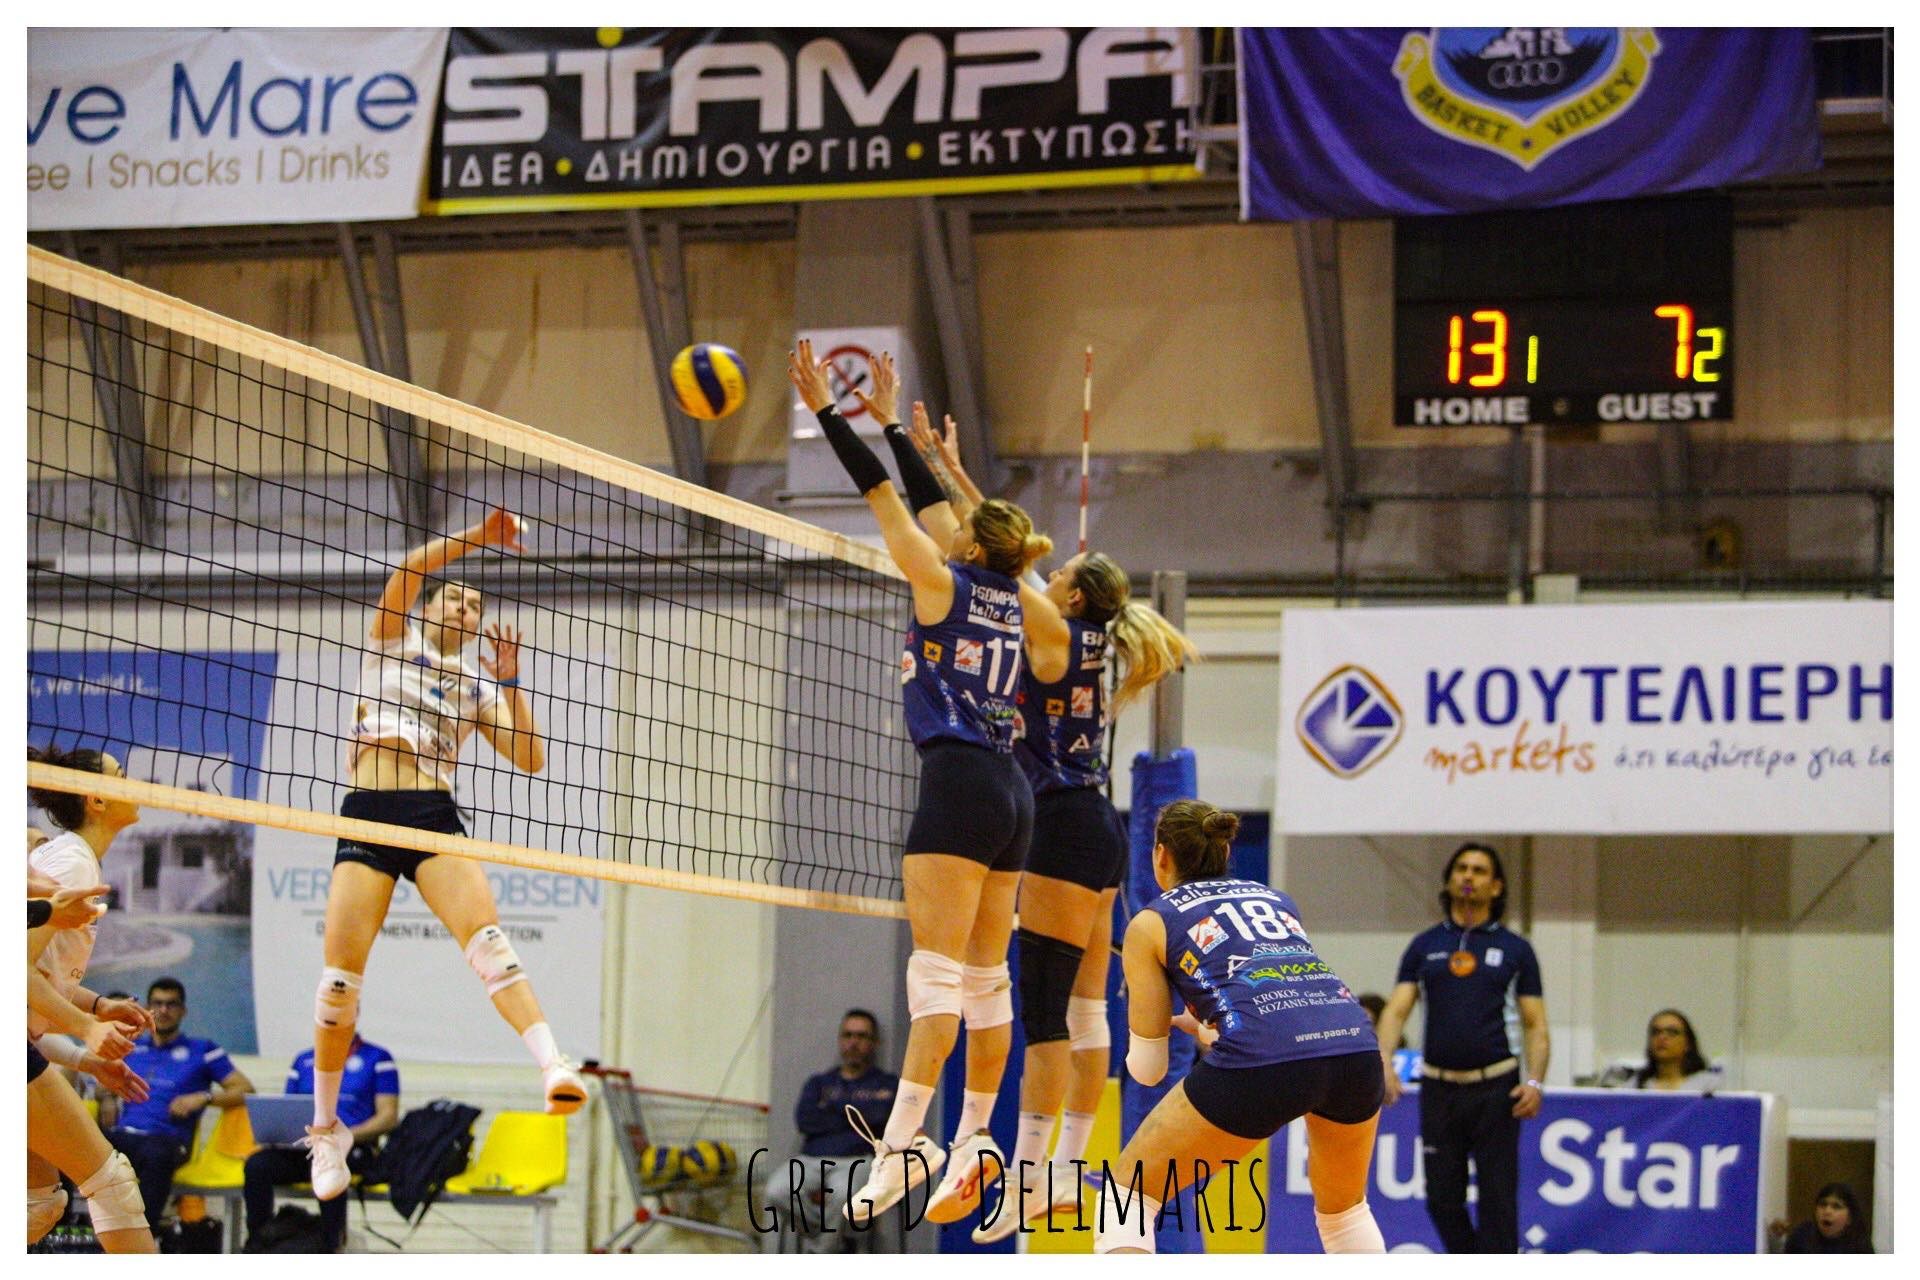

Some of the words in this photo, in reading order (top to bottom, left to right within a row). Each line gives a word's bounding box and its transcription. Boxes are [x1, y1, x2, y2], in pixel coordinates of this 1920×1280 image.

[167, 59, 419, 140] Mare
[1415, 84, 1509, 142] BASKET
[1545, 67, 1636, 137] VOLLEY
[108, 148, 241, 190] Snacks
[278, 143, 391, 184] Drinks
[442, 151, 545, 189] ΙΔΕΑ
[584, 135, 892, 183] ΔΗΜΙΟΥΡΓΙΑ
[1448, 310, 1508, 388] 13
[1654, 304, 1693, 380] 7
[1693, 327, 1725, 382] 2
[1413, 396, 1530, 425] HOME
[1597, 391, 1718, 422] GUEST
[986, 636, 1020, 697] 17
[1423, 719, 1597, 785] markets
[1168, 889, 1212, 907] hello
[1212, 899, 1290, 942] 18
[1252, 987, 1300, 1006] KROKOS
[1257, 998, 1310, 1015] KOZANIS
[1294, 1026, 1362, 1044] www.paon.gr
[1537, 1117, 1741, 1210] Star
